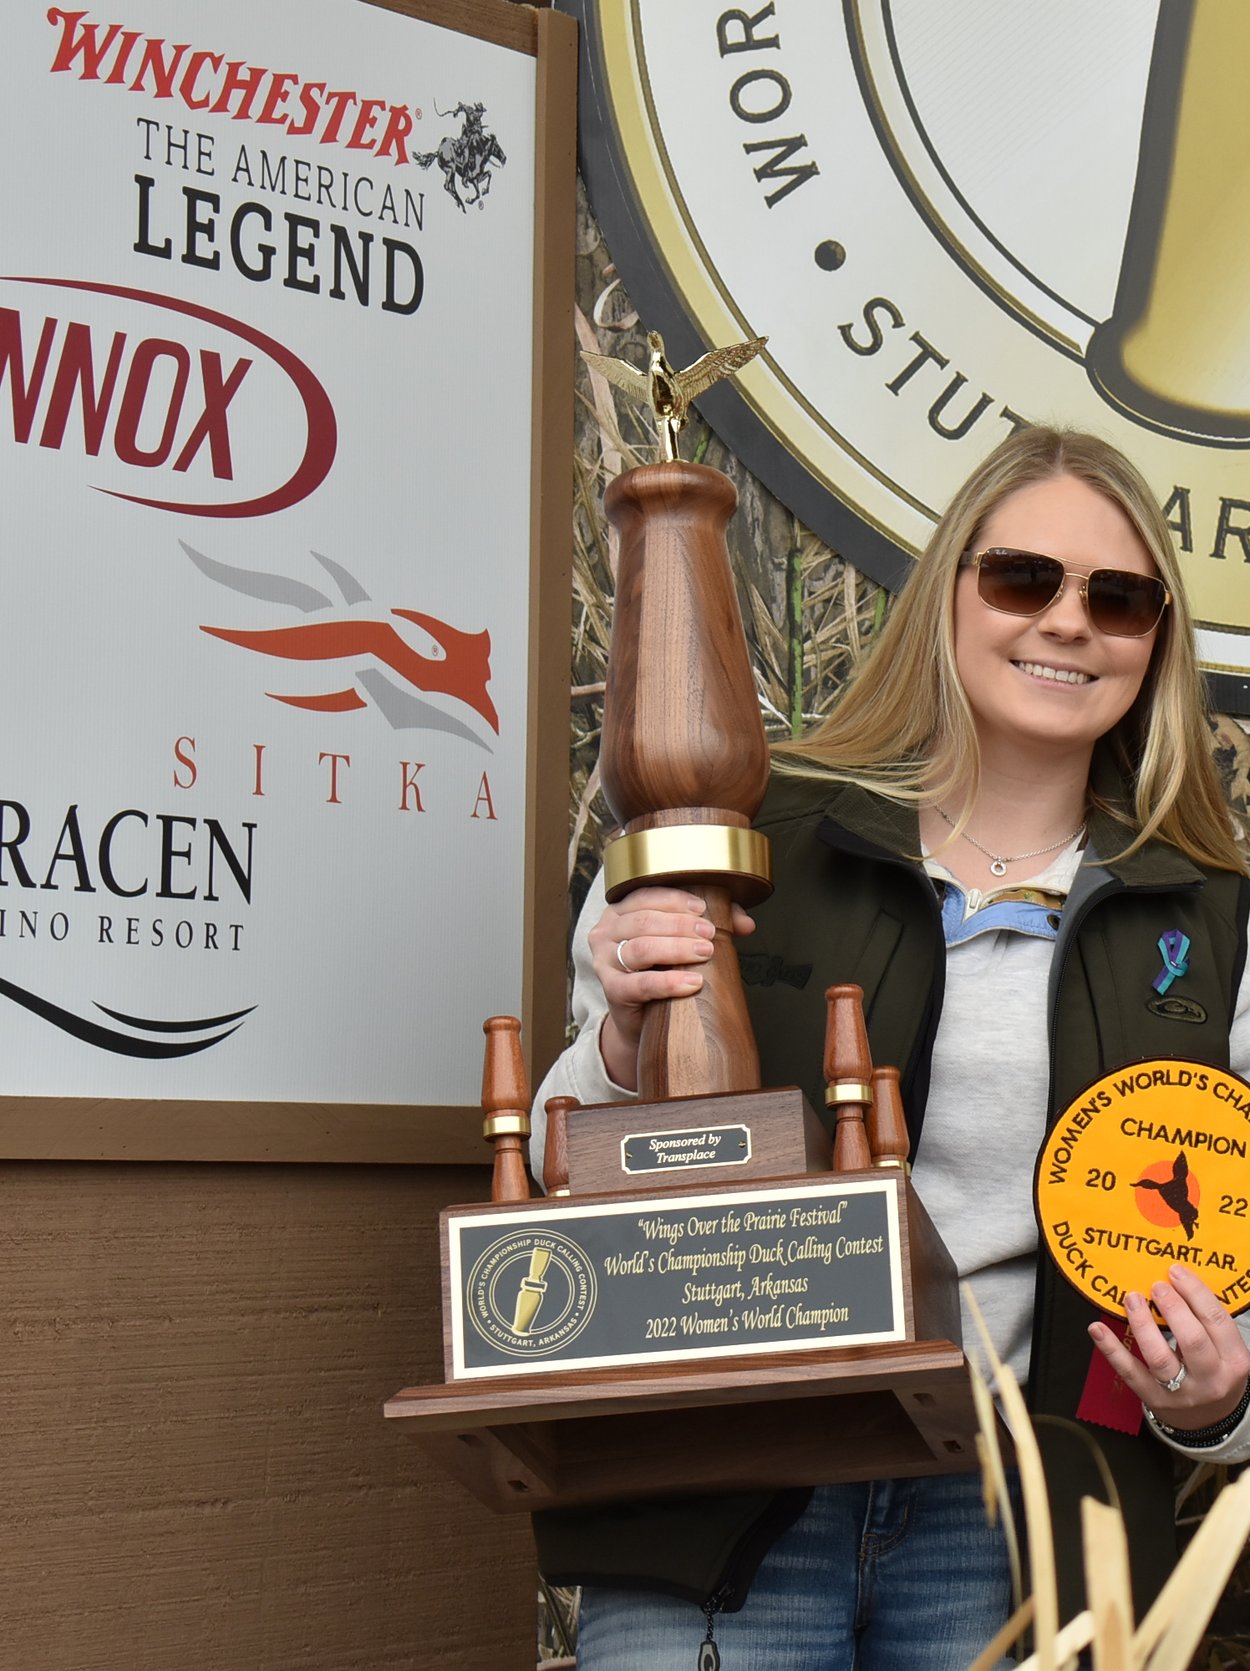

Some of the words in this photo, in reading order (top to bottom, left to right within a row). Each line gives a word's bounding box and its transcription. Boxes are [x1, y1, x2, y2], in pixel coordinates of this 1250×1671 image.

[47, 7, 414, 166] WINCHESTER
[136, 117, 216, 176] THE
[231, 144, 425, 231] AMERICAN
[133, 173, 425, 315] LEGEND
[173, 736, 498, 821] SITKA
[0, 799, 257, 906] RACEN
[98, 915, 244, 952] RESORT
[649, 1134, 706, 1152] Sponsored
[708, 1133, 721, 1146] by
[1049, 1090, 1112, 1184] WOMEN'S
[1113, 1069, 1209, 1097] WORLD'S
[1120, 1117, 1247, 1158] CHAMPION
[656, 1149, 716, 1164] Transplace
[1085, 1168, 1116, 1191] 20
[1218, 1195, 1248, 1217] 22
[688, 1216, 718, 1237] Over
[721, 1210, 741, 1233] the
[743, 1207, 787, 1232] Prairie
[482, 1238, 532, 1280] CHAMPIONSHIP
[534, 1238, 556, 1249] DUCK
[557, 1245, 582, 1273] CALLING
[604, 1251, 655, 1277] World's
[657, 1243, 746, 1275] Championship
[749, 1240, 787, 1266] Duck
[788, 1236, 832, 1264] Calling
[835, 1235, 884, 1258] Contest
[1052, 1220, 1094, 1279] DUCK
[1082, 1227, 1202, 1266] STUTTGART,
[1205, 1252, 1238, 1272] AR.
[477, 1281, 489, 1318] WORLD'S
[578, 1273, 587, 1311] CONTEST
[682, 1278, 745, 1307] Stuttgart,
[747, 1272, 808, 1300] Arkansas
[490, 1324, 536, 1347] STUTTGART,
[538, 1317, 577, 1346] ARKANSAS
[645, 1316, 677, 1339] 2022
[680, 1309, 739, 1335] Women's
[742, 1304, 782, 1330] World
[785, 1303, 849, 1331] Champion
